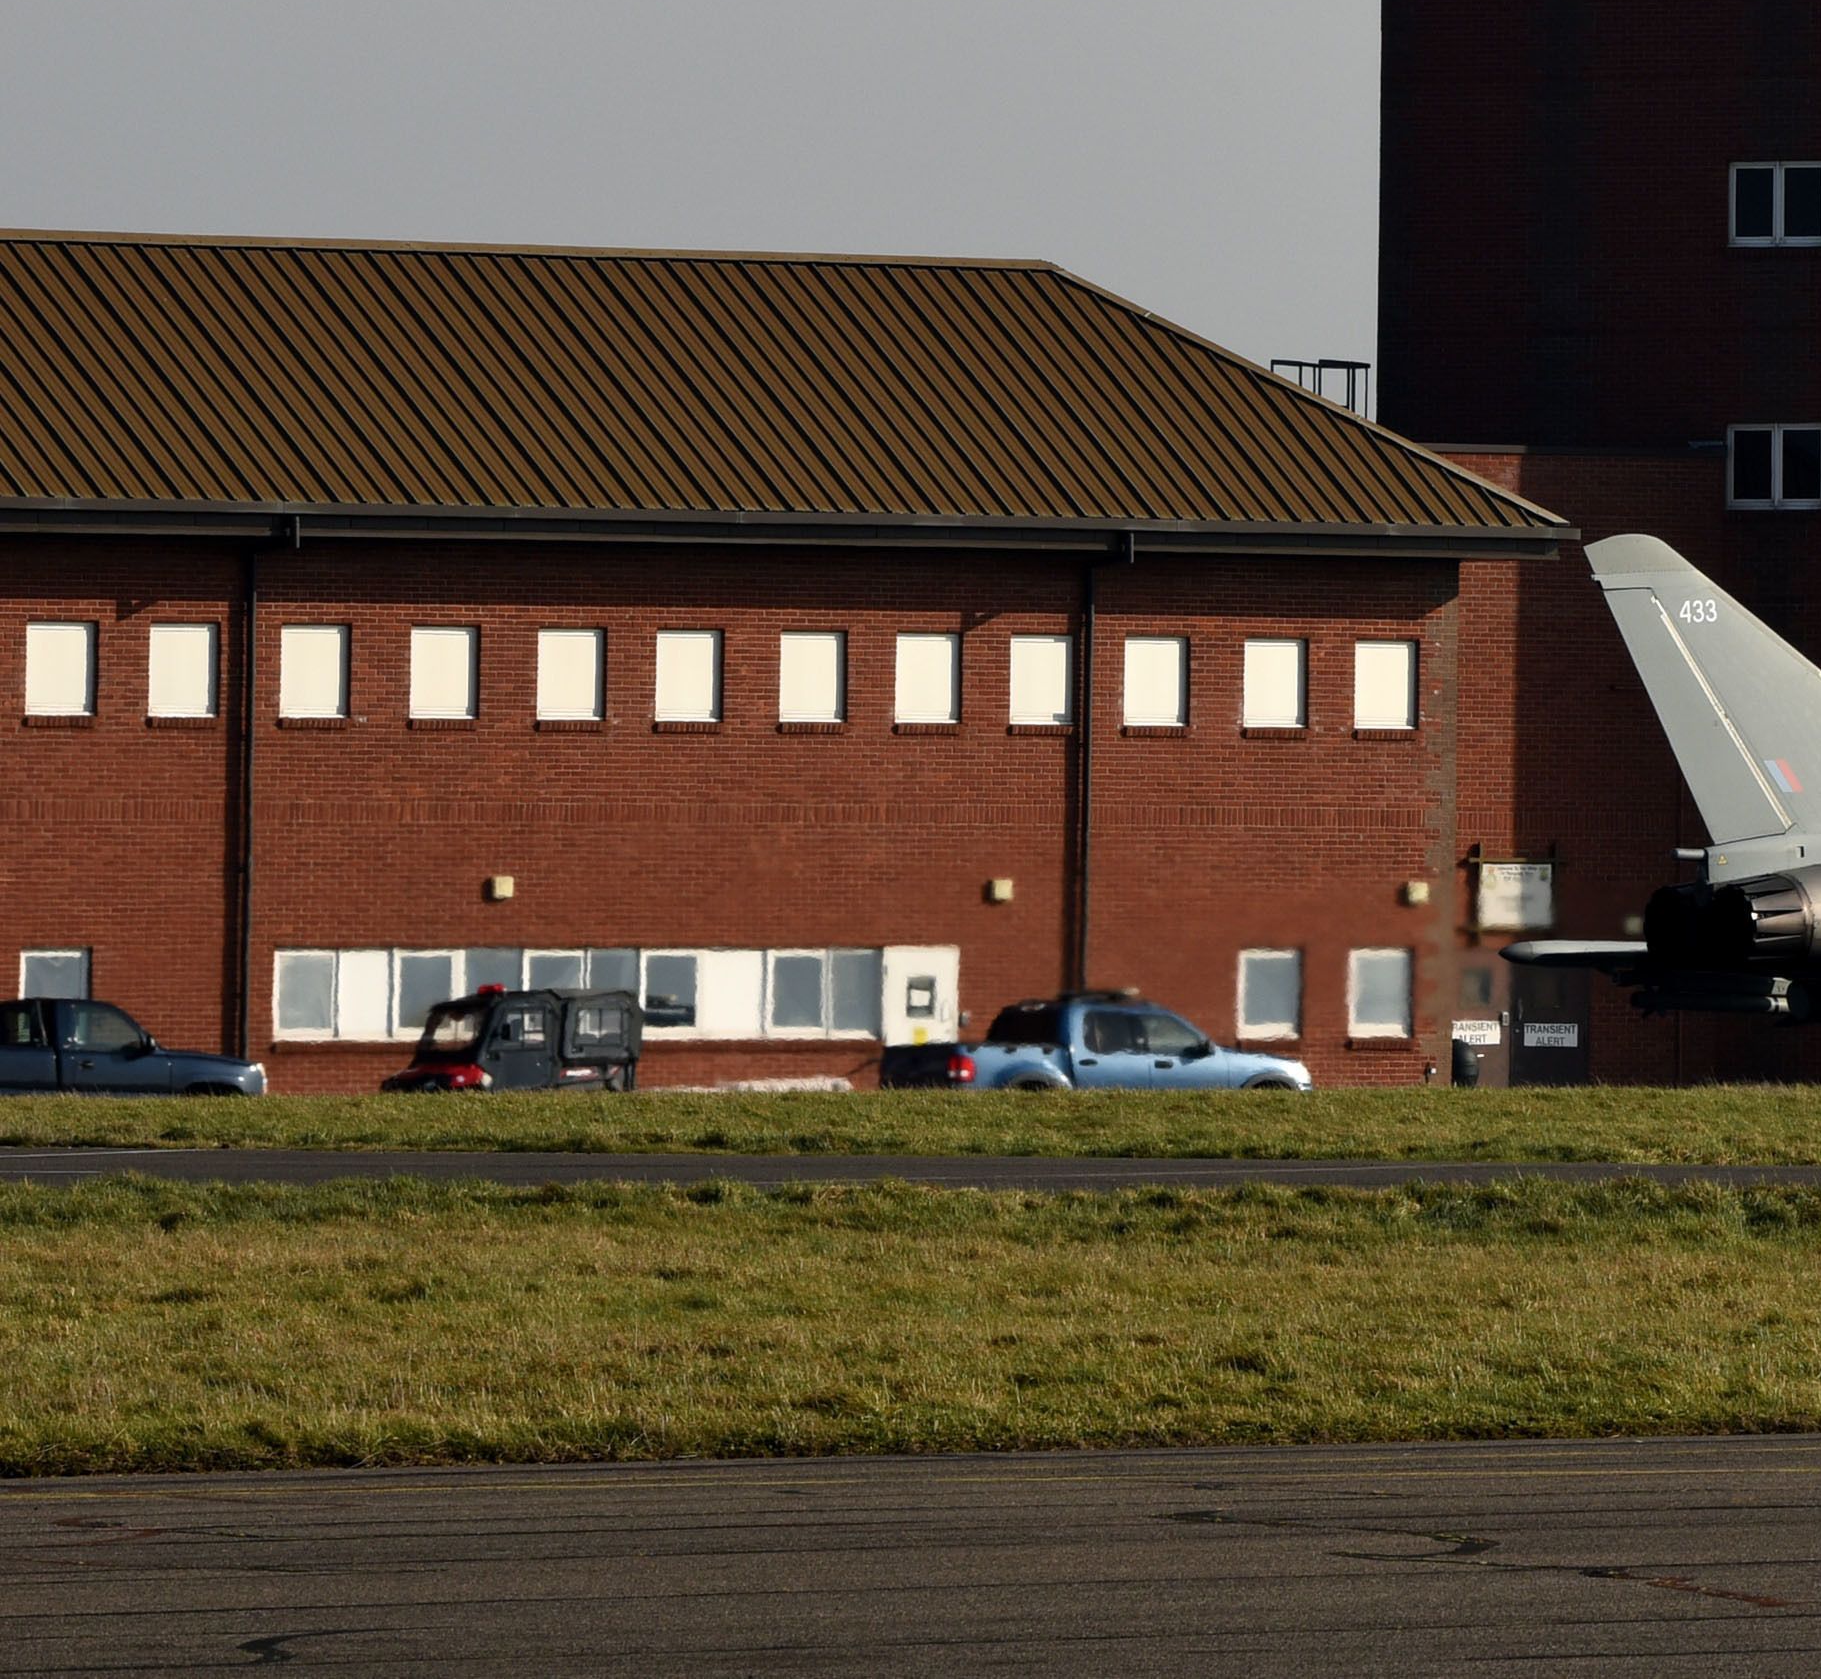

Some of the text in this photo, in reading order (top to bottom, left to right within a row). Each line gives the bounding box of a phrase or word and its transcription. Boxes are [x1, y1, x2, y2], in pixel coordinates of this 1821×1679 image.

[1679, 598, 1718, 624] 433
[1525, 1024, 1576, 1035] TRANSIENT
[1535, 1036, 1566, 1046] ALERT
